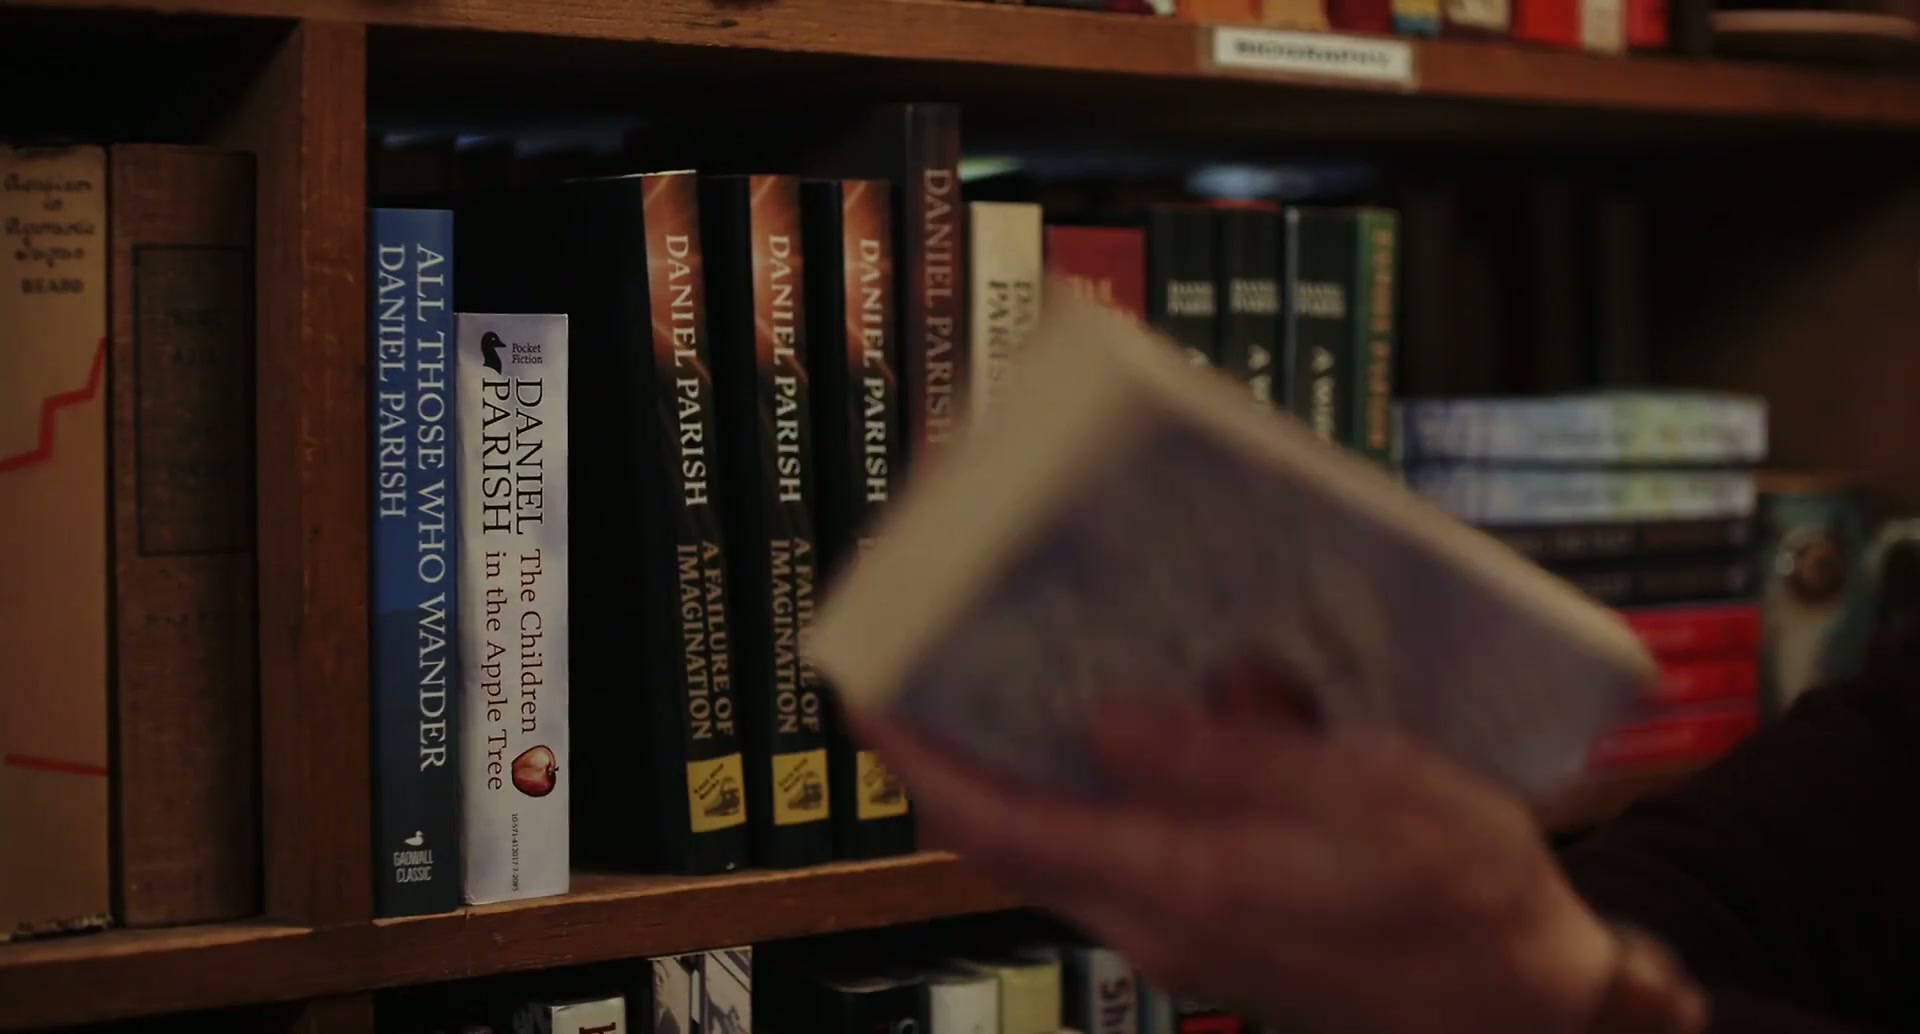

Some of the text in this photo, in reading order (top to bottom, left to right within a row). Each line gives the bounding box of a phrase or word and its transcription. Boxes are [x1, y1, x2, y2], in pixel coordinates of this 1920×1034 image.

[378, 243, 407, 519] DANIEL PARISH
[512, 342, 541, 353] Pocket
[512, 354, 543, 364] Fiction
[665, 234, 708, 507] DANIEL PARISH
[769, 234, 802, 504] DANIEL PARISH
[859, 238, 889, 504] DANIEL PARISH
[924, 168, 953, 443] DANIEL PARISH
[416, 243, 446, 772] ALL THOSE WHO WANDER
[481, 377, 512, 791] PARISH in the Apple Tree
[515, 377, 544, 733] DANIEL The Children
[793, 536, 812, 557] A
[676, 543, 713, 741] IMAGINATION
[702, 539, 736, 737] A FAILURE OF
[769, 538, 800, 735] IMAGINATION
[800, 691, 820, 734] OF
[393, 850, 434, 867] GADWALL
[396, 866, 432, 883] CLASSIC
